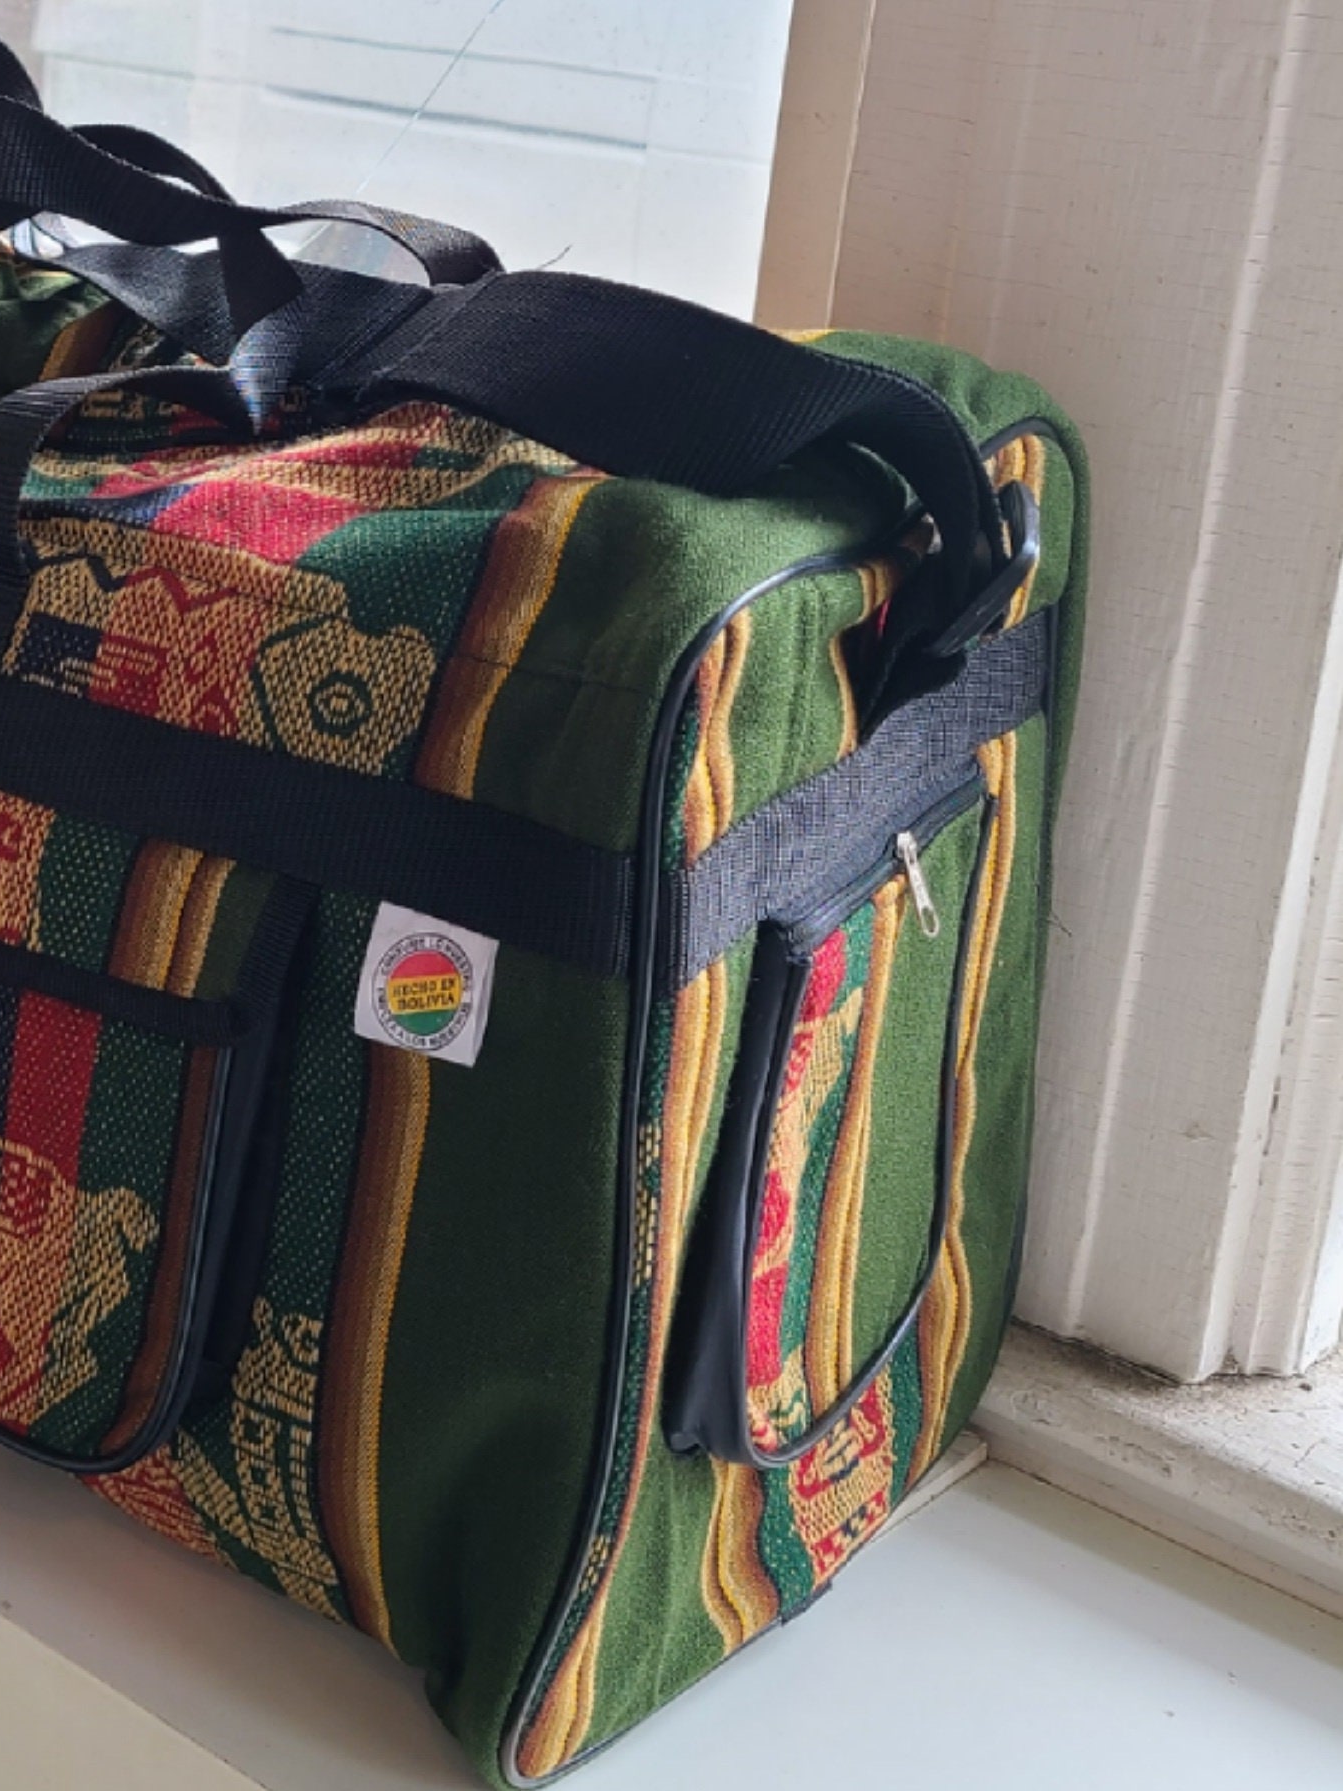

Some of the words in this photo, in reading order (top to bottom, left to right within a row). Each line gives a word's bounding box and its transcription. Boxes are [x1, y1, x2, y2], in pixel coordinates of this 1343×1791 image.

[393, 980, 437, 997] HECHO
[441, 978, 457, 991] EN
[397, 993, 455, 1010] BOLIVIA
